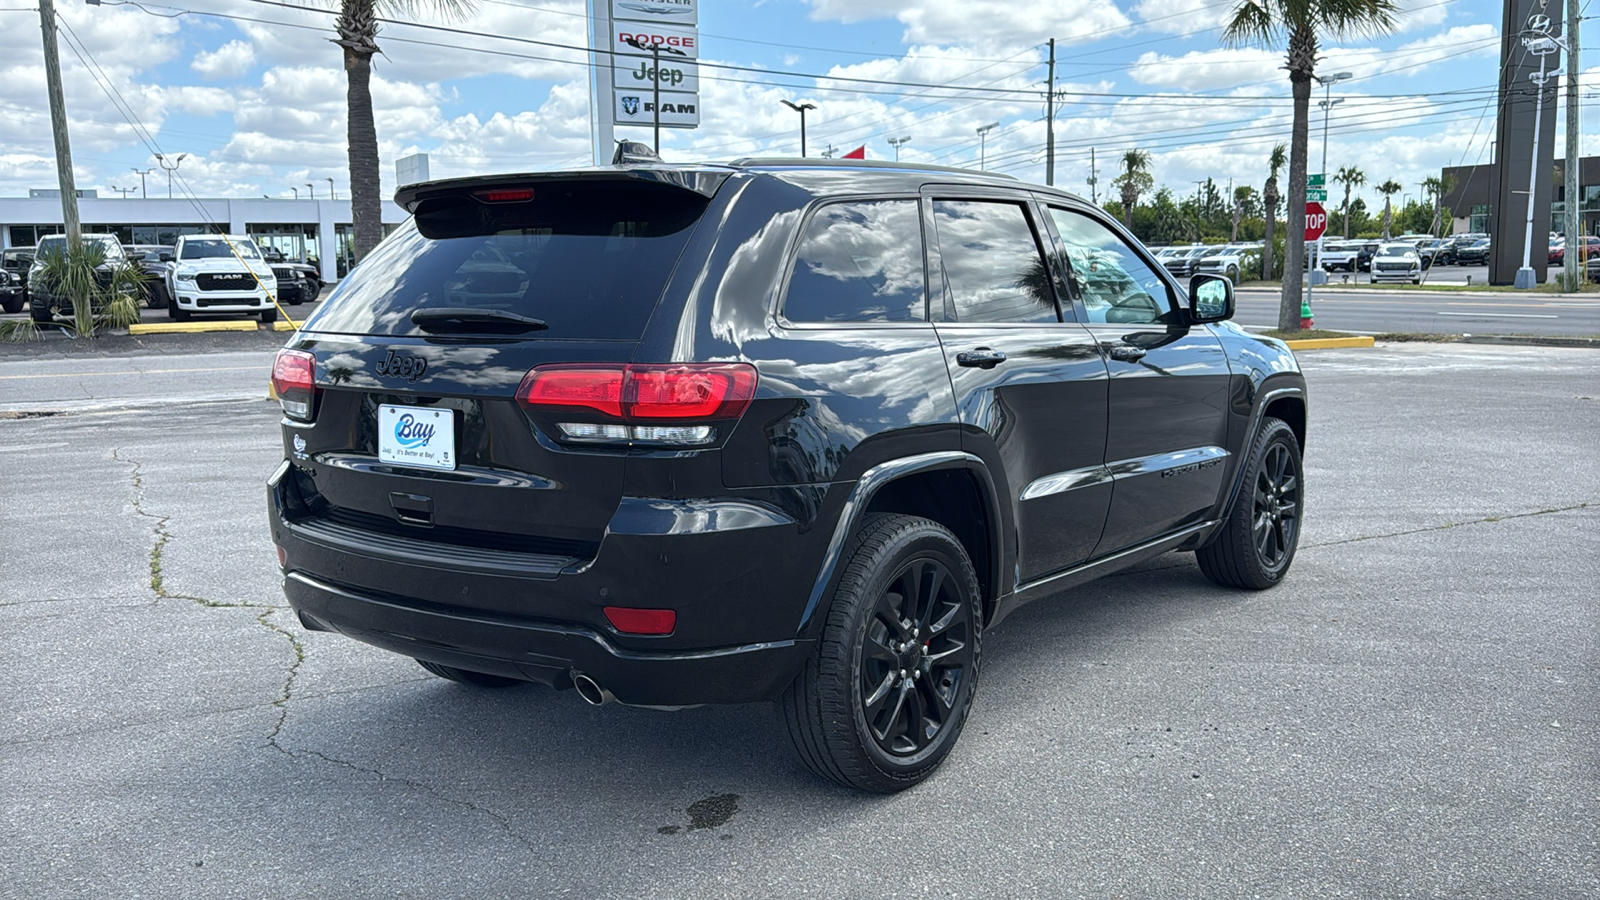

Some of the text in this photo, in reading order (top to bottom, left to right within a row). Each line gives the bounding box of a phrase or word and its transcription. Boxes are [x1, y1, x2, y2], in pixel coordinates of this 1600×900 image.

[619, 32, 694, 47] DODGE
[632, 62, 683, 86] Jeep
[644, 102, 695, 114] RAM
[1306, 191, 1320, 200] orida
[1305, 213, 1325, 230] TOP
[376, 350, 427, 382] Jeep
[397, 413, 436, 447] Bay
